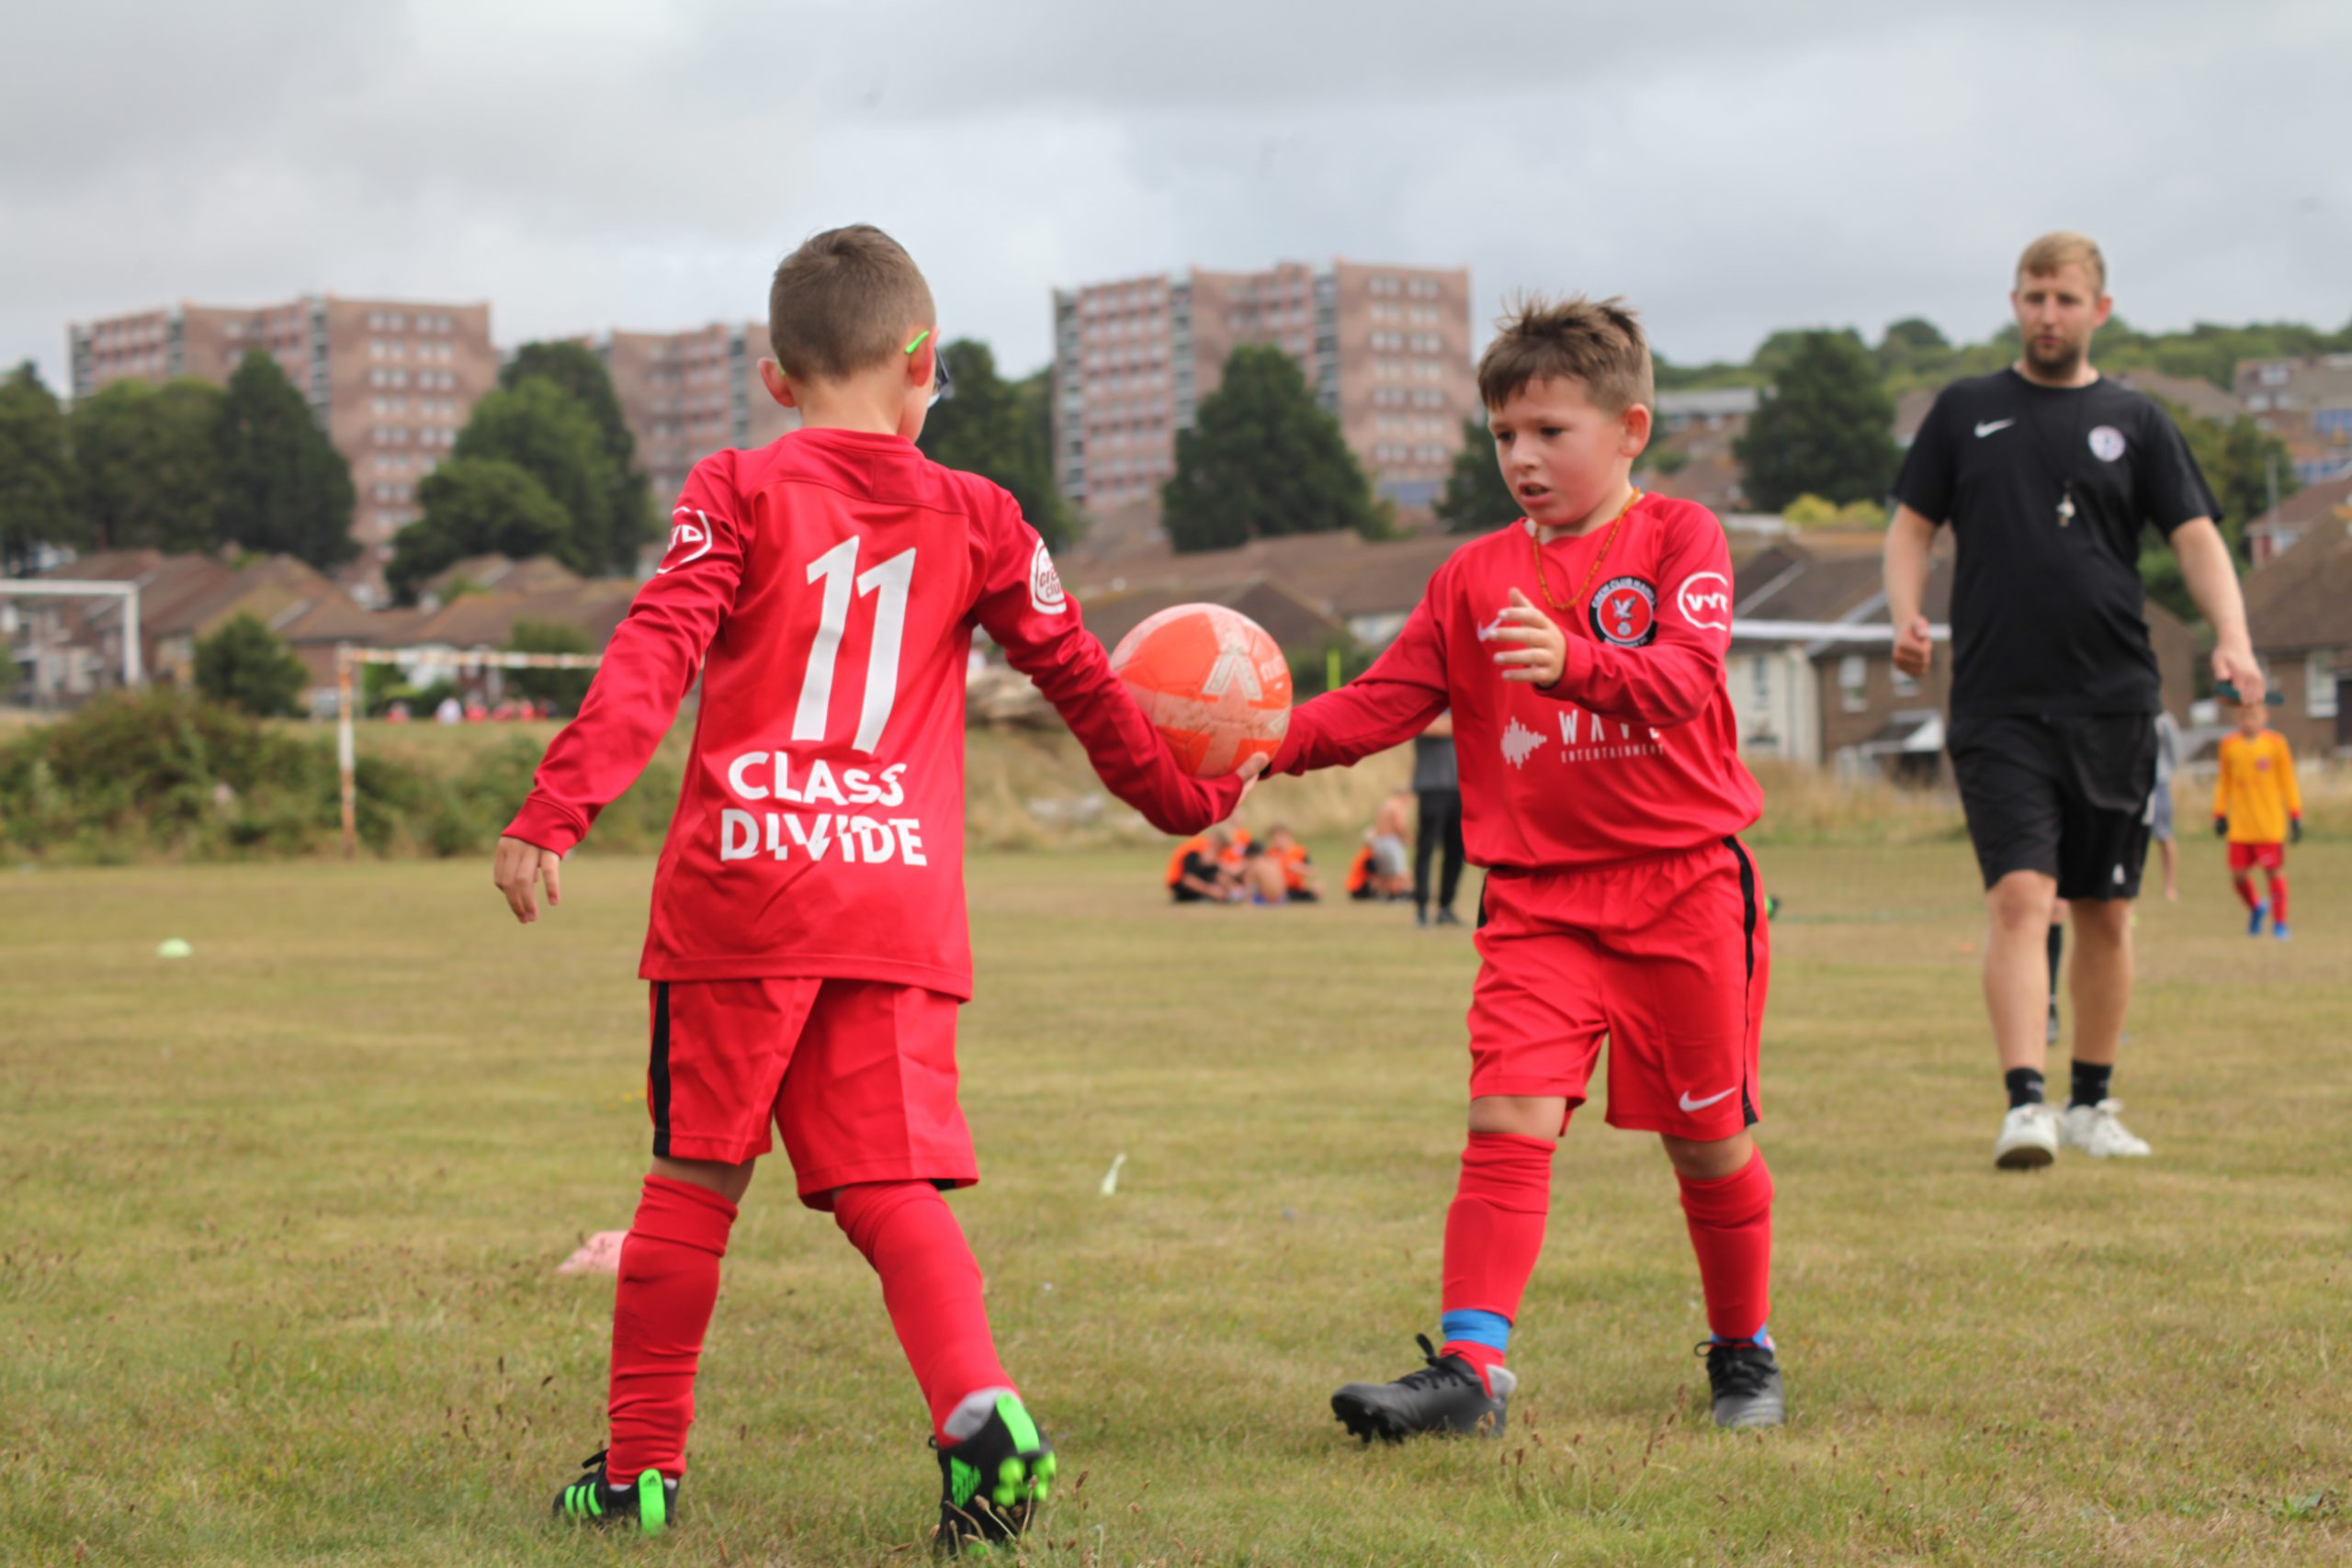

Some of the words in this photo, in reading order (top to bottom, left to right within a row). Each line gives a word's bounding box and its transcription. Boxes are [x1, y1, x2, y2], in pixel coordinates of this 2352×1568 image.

[791, 536, 916, 755] 11
[729, 750, 907, 807] CLASS
[720, 807, 927, 867] DIVIDE
